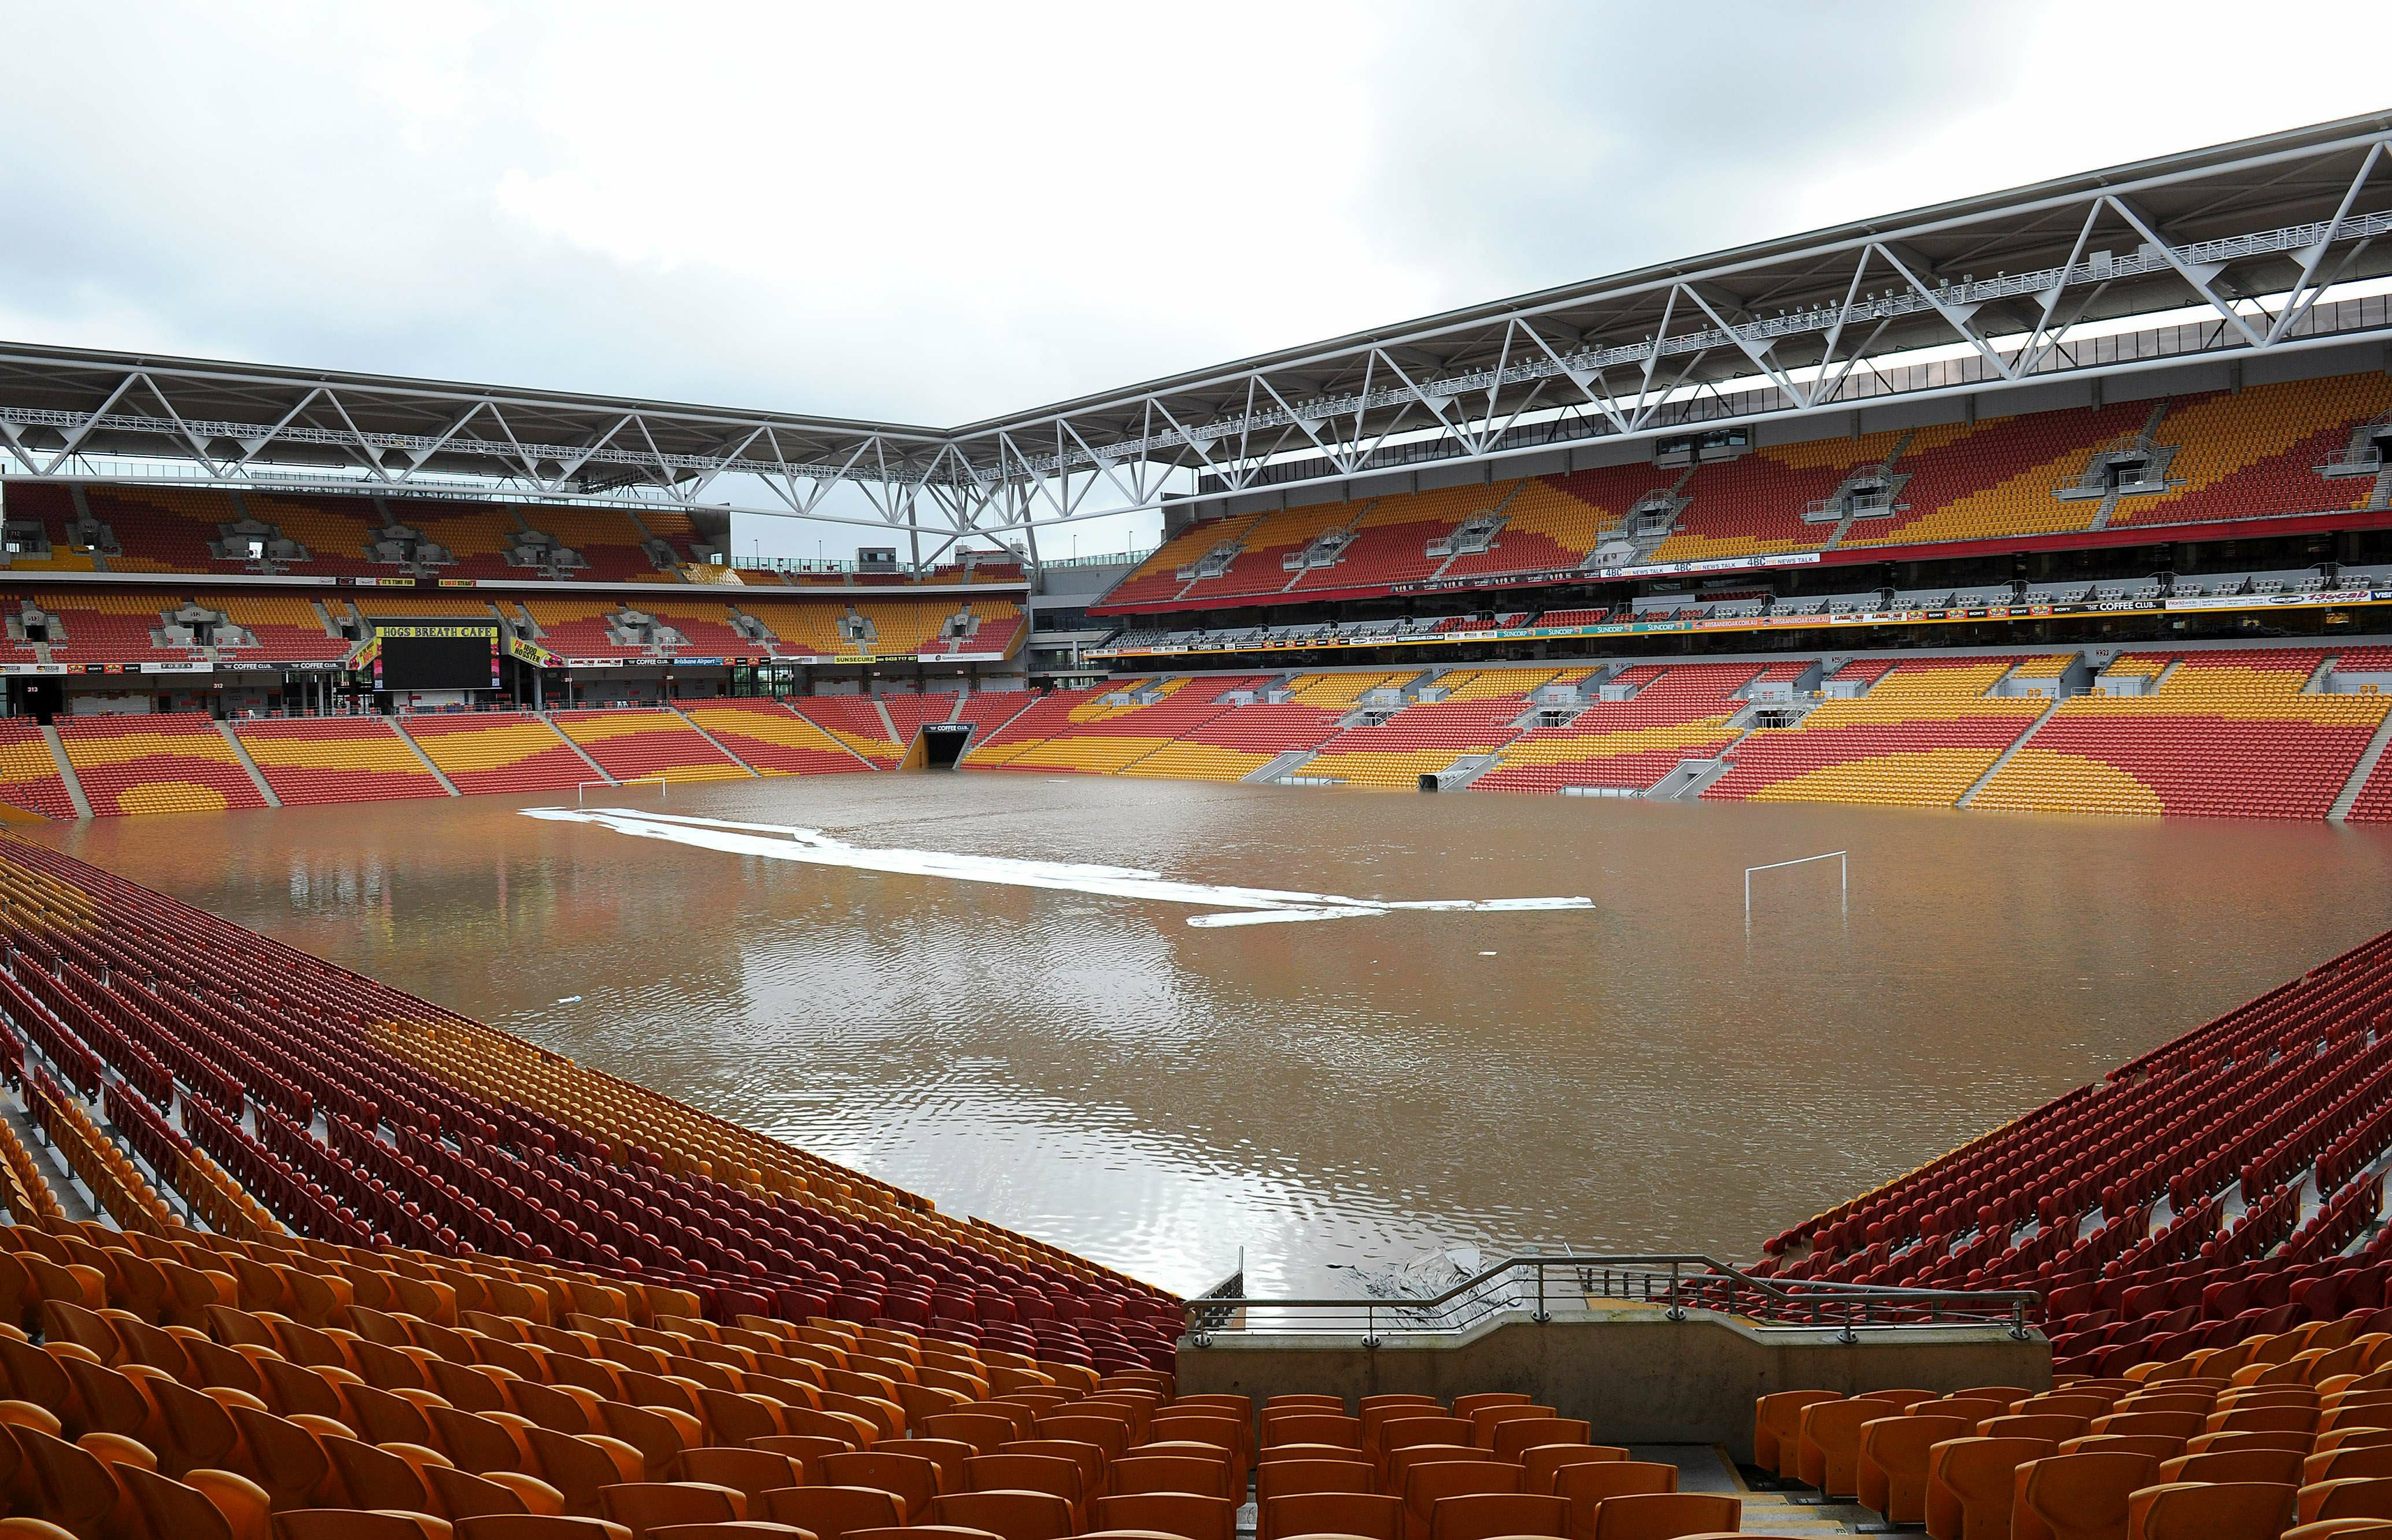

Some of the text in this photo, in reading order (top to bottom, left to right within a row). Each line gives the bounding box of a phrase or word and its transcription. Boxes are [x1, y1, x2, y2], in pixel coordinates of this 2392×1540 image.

[1747, 557, 1766, 567] 4BC
[1674, 563, 1692, 572] 4BC
[1605, 568, 1622, 577] 4BC
[2099, 602, 2134, 611] COFFEE
[383, 627, 492, 636] HOGS BREATH CAFE
[523, 644, 537, 655] 1800
[514, 647, 540, 663] HOGSTER
